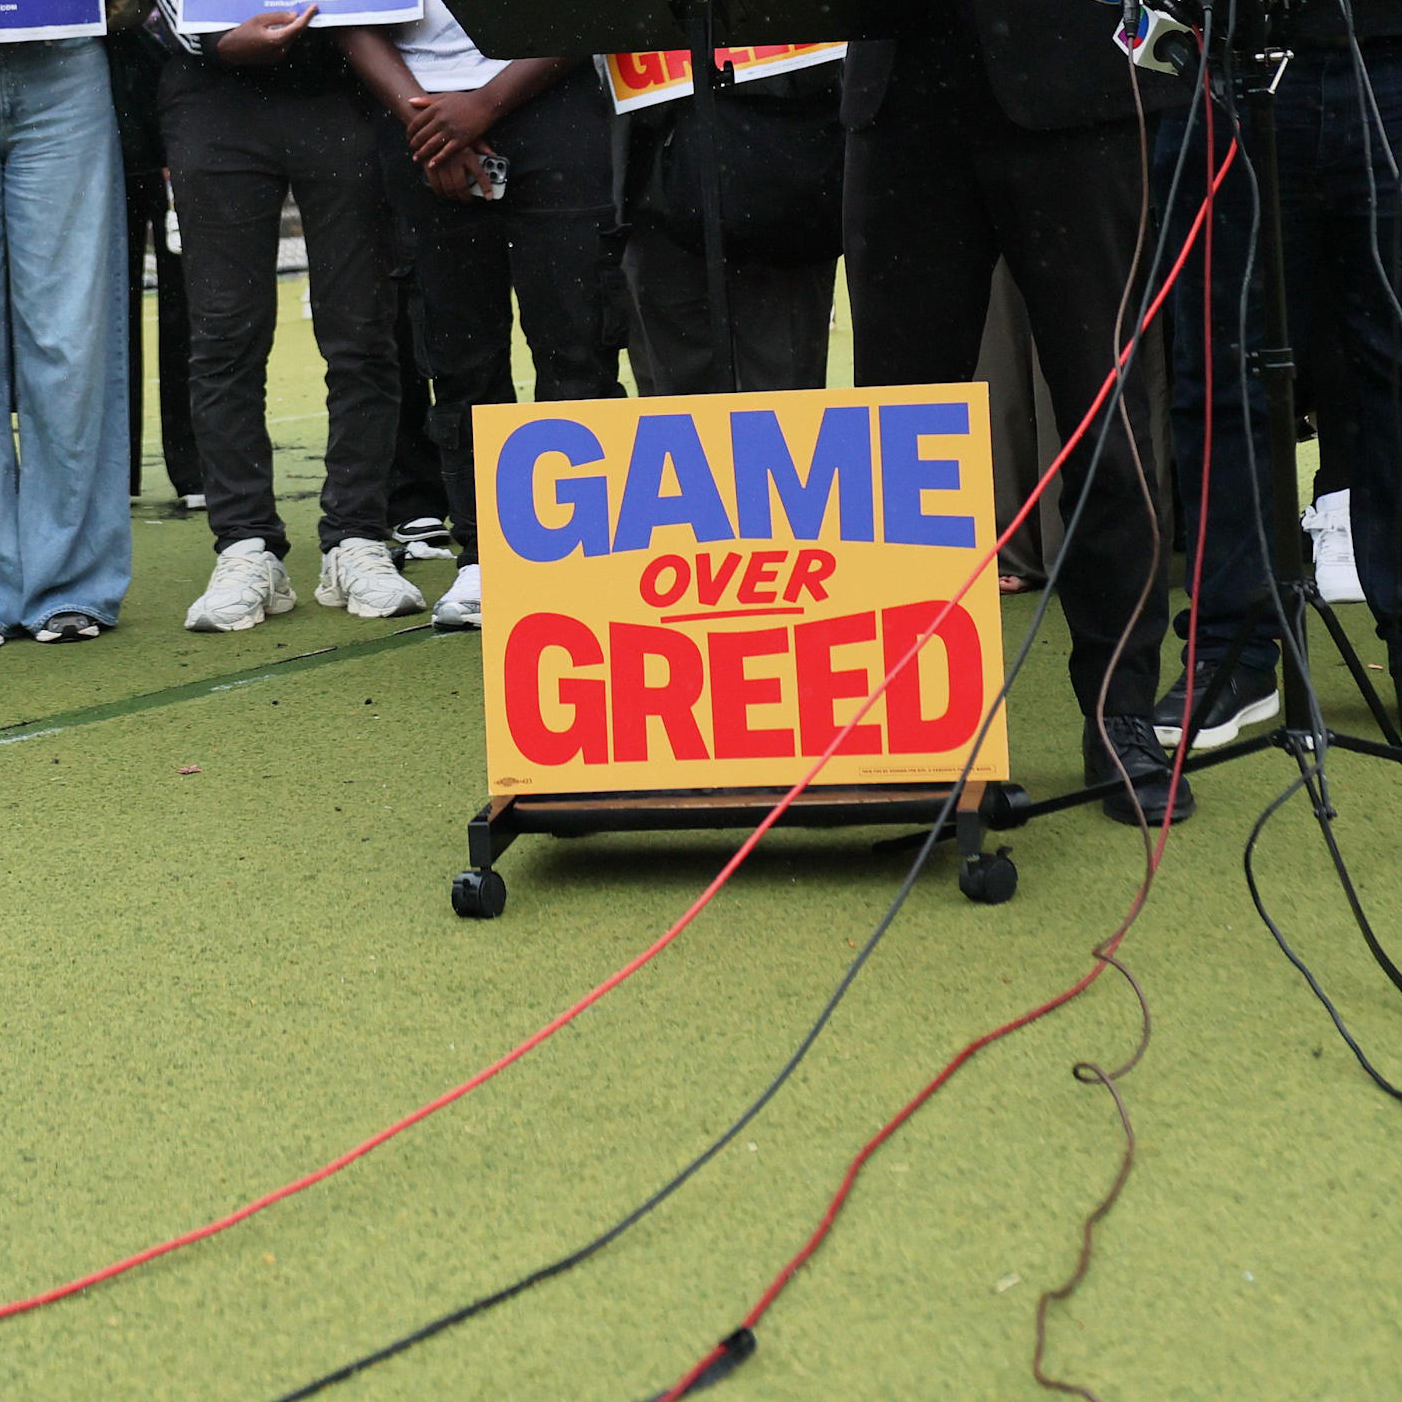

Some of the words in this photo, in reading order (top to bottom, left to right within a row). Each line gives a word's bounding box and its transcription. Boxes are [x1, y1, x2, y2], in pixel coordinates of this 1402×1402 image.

[495, 402, 976, 563] GAME
[639, 549, 837, 608] OVER
[504, 600, 984, 766] GREED
